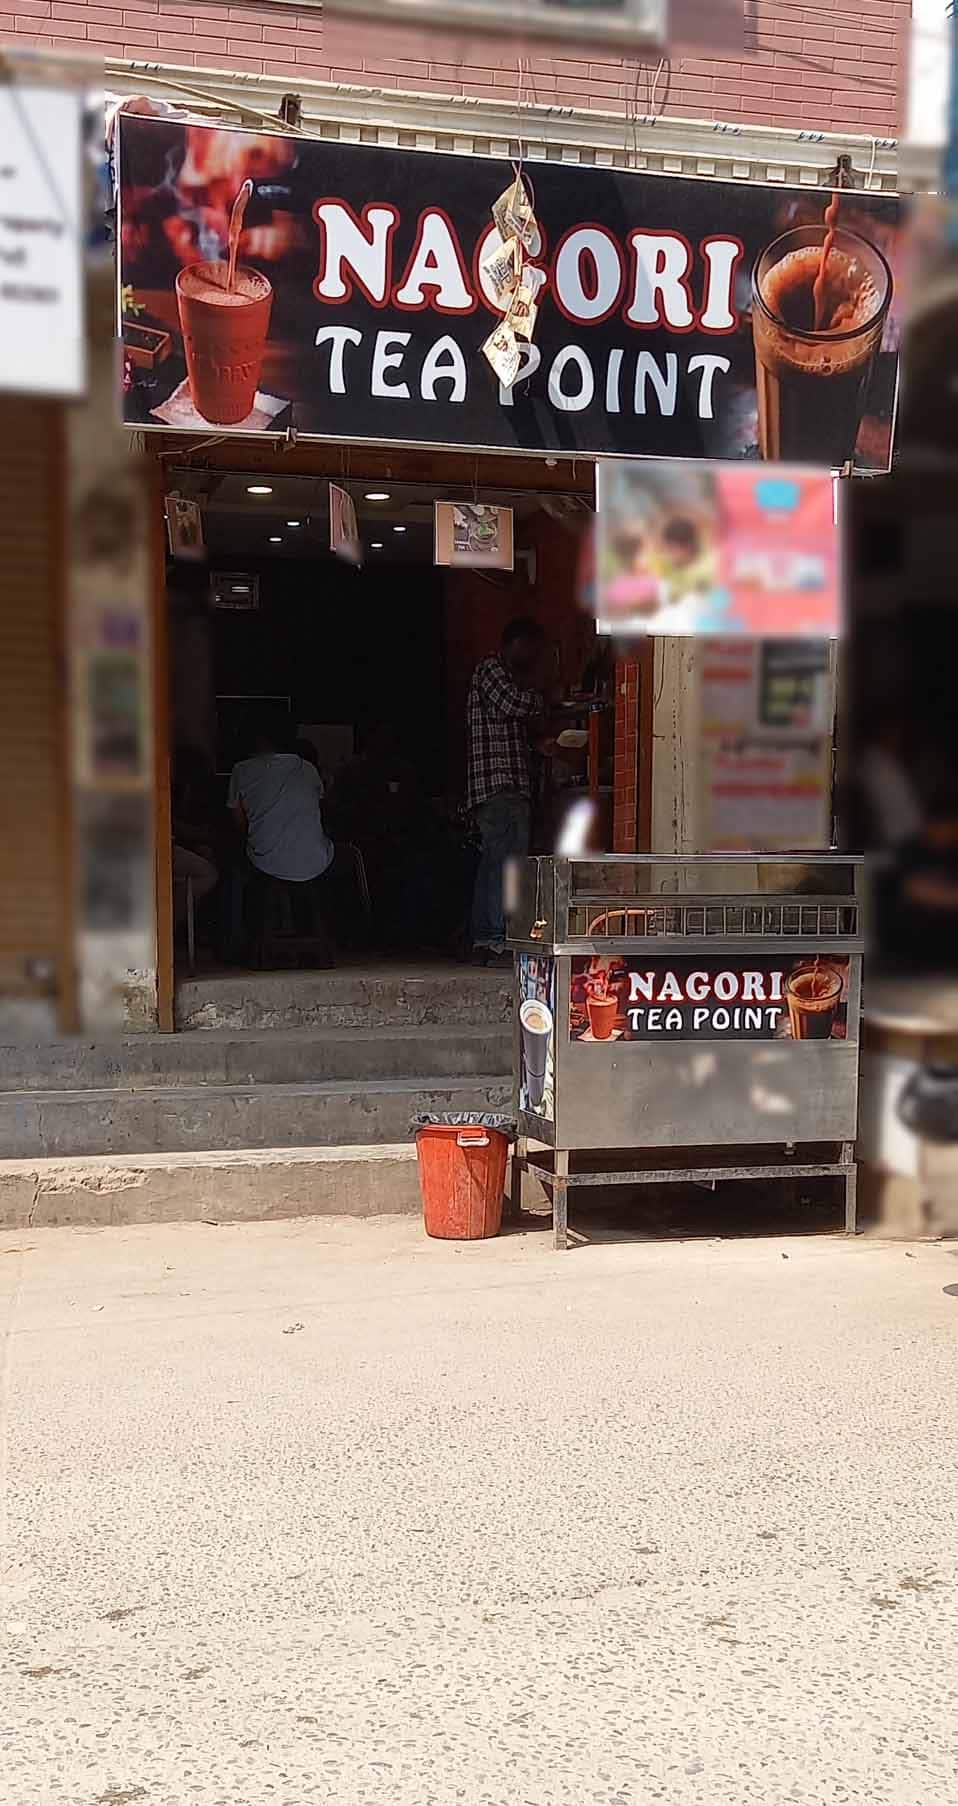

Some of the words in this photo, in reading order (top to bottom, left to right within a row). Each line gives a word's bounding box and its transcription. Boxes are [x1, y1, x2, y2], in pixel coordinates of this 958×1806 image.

[315, 326, 468, 402] TEA
[627, 970, 784, 1003] NAGORI
[627, 1007, 683, 1032] TEA
[693, 1007, 783, 1031] POINT
